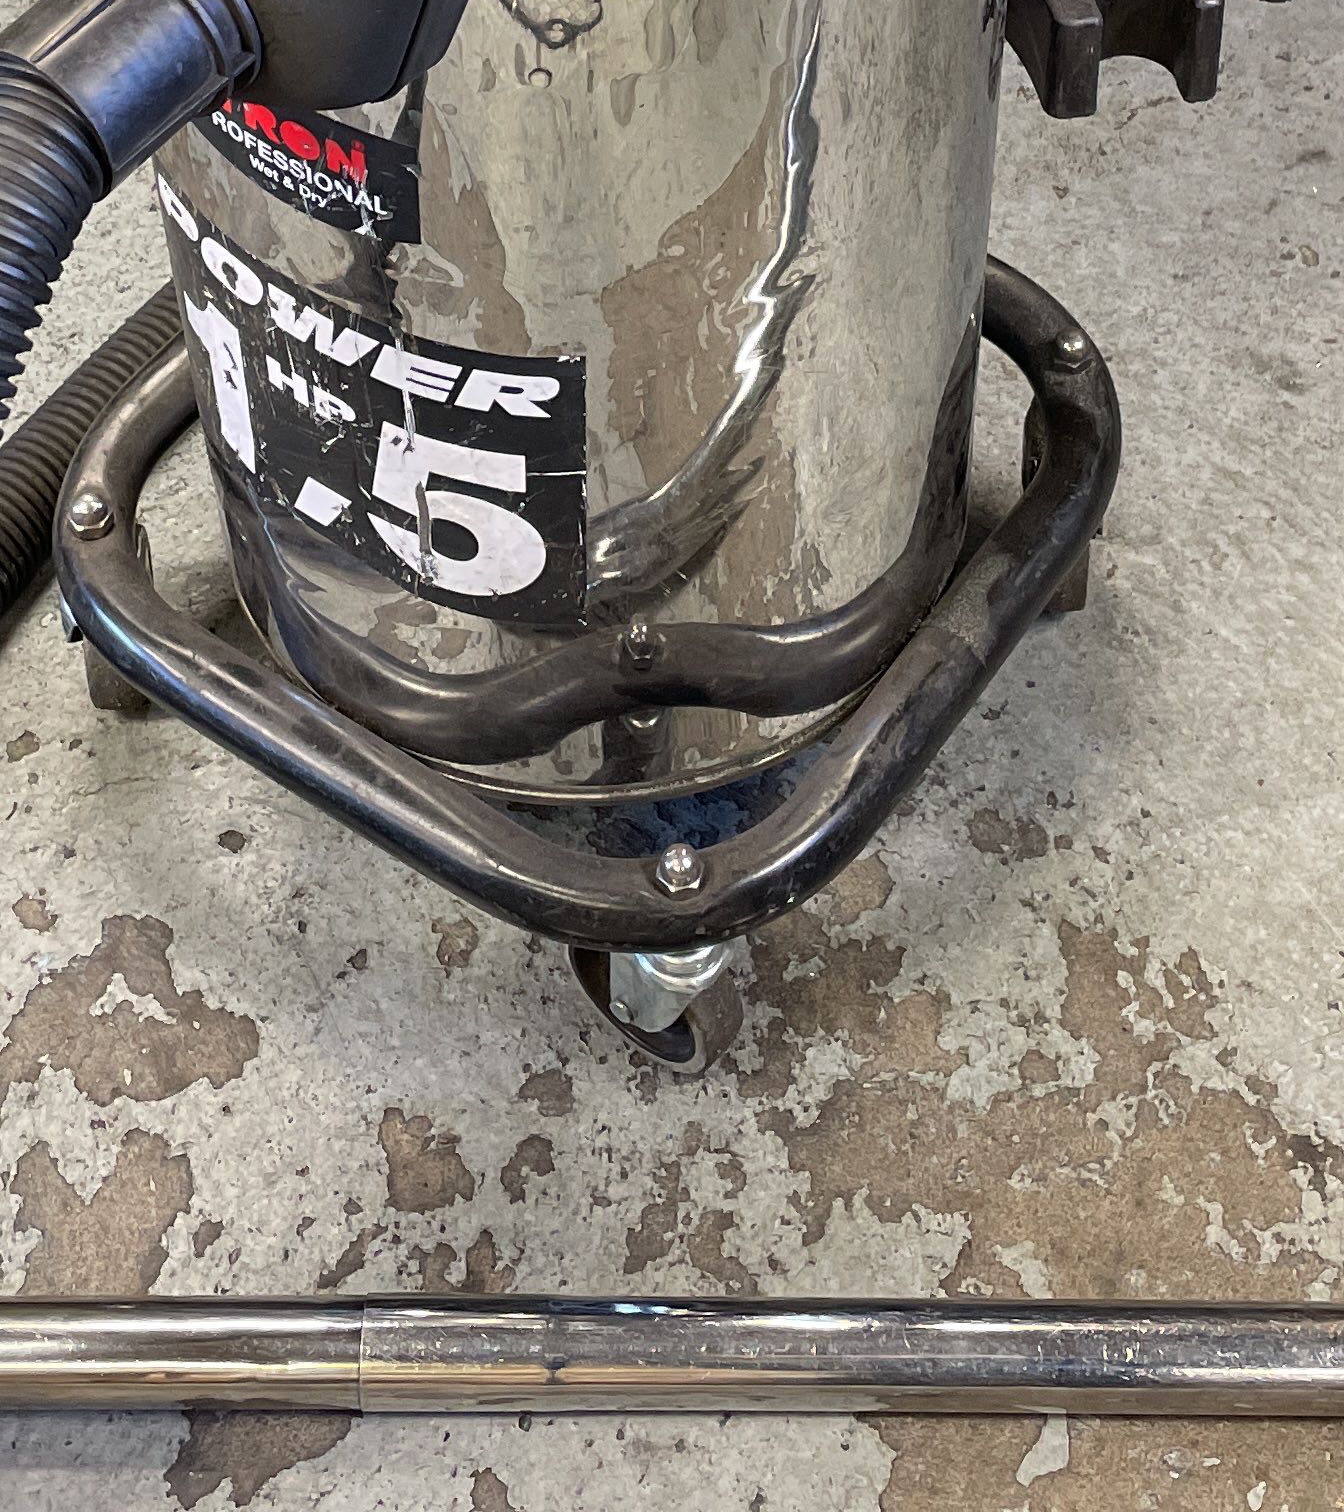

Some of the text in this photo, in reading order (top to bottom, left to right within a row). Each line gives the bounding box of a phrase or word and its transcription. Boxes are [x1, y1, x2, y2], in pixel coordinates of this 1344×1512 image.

[211, 110, 388, 216] ROFESSIONAL
[249, 153, 327, 208] Wet & Dry
[157, 172, 560, 419] POWER
[265, 354, 356, 423] HP
